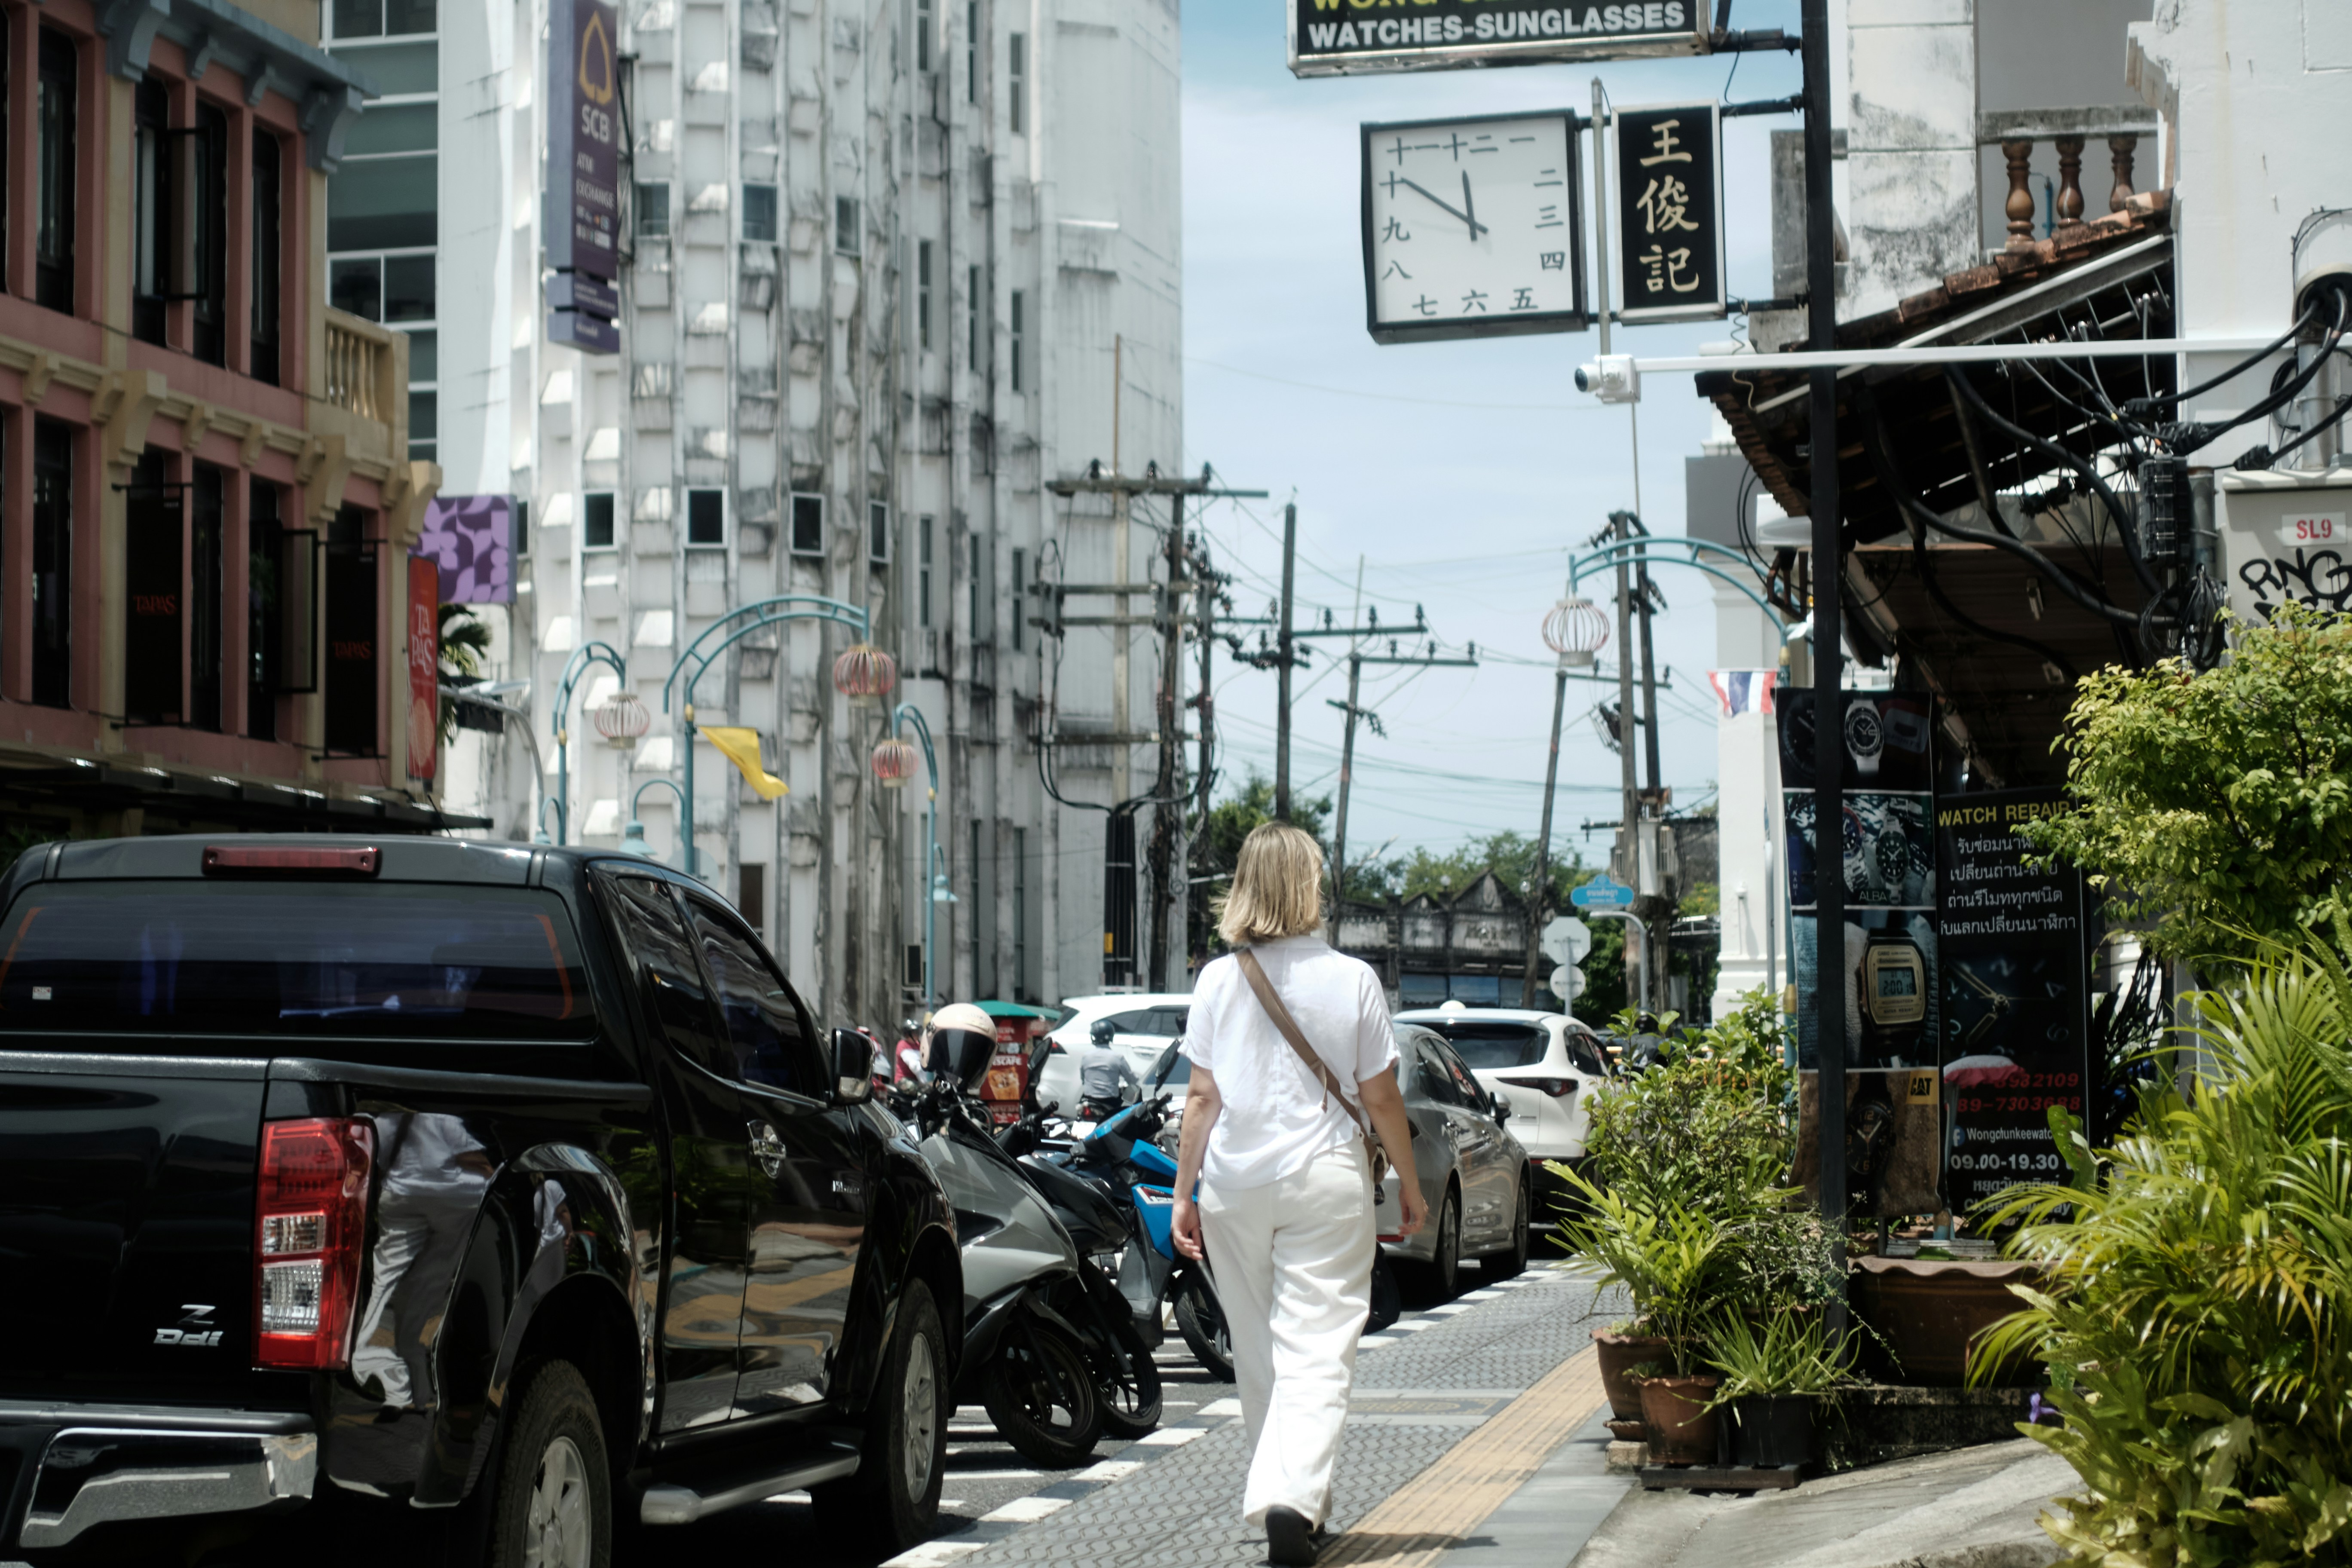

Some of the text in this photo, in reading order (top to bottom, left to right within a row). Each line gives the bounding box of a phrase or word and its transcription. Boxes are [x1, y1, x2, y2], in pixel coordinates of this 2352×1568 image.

[1308, 2, 1684, 48] WATCHES-SUNGLASSES
[582, 103, 609, 144] SCB
[576, 178, 615, 209] EXCHANGE
[1535, 206, 1564, 228] 三
[1381, 216, 1411, 243] 九
[1382, 260, 1412, 280] 八
[1540, 252, 1565, 271] 四
[1412, 295, 1438, 315] 七
[1462, 290, 1488, 313] 六
[1510, 288, 1538, 311] 五
[2297, 519, 2332, 539] SL9
[1939, 806, 1997, 827] WATCH
[2006, 801, 2070, 821] REPAIR
[1859, 891, 1887, 901] ALBA
[1911, 1078, 1932, 1096] CAT
[1946, 1096, 2081, 1112] 89-7303688
[1951, 1154, 2059, 1170] 09.00-19.30
